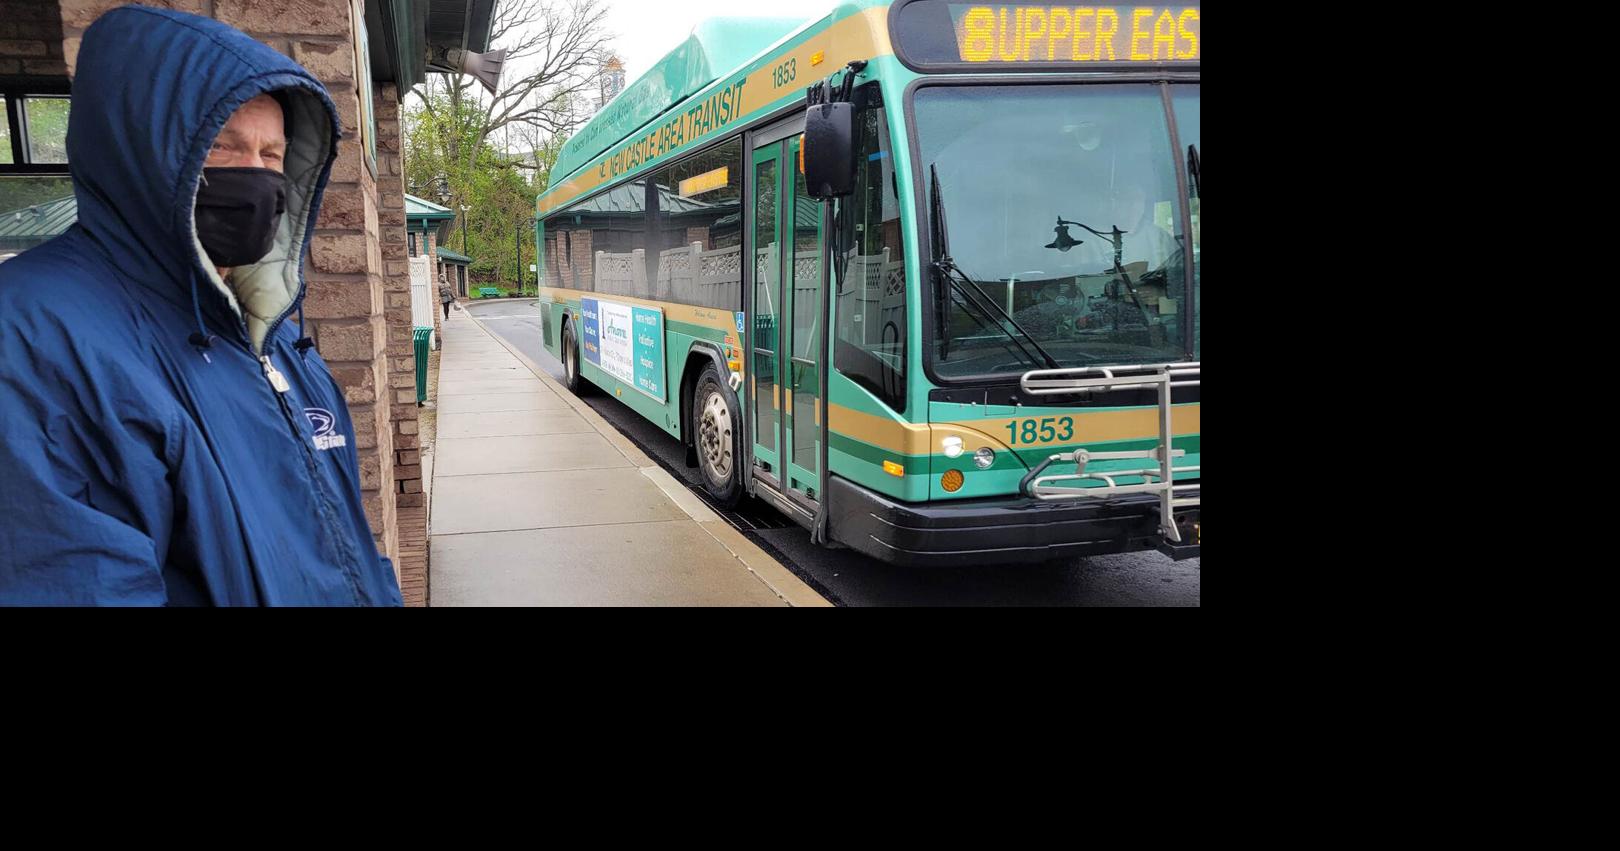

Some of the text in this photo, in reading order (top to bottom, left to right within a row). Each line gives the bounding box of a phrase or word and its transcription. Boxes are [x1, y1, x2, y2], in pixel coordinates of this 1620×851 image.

[963, 7, 1199, 61] 8 UPPER EAS
[772, 58, 797, 89] 1853
[609, 150, 627, 179] NEW
[625, 131, 656, 170] CASTLE
[657, 117, 684, 155] AREA
[686, 78, 747, 141] TRANSIT
[1005, 416, 1074, 445] 1853
